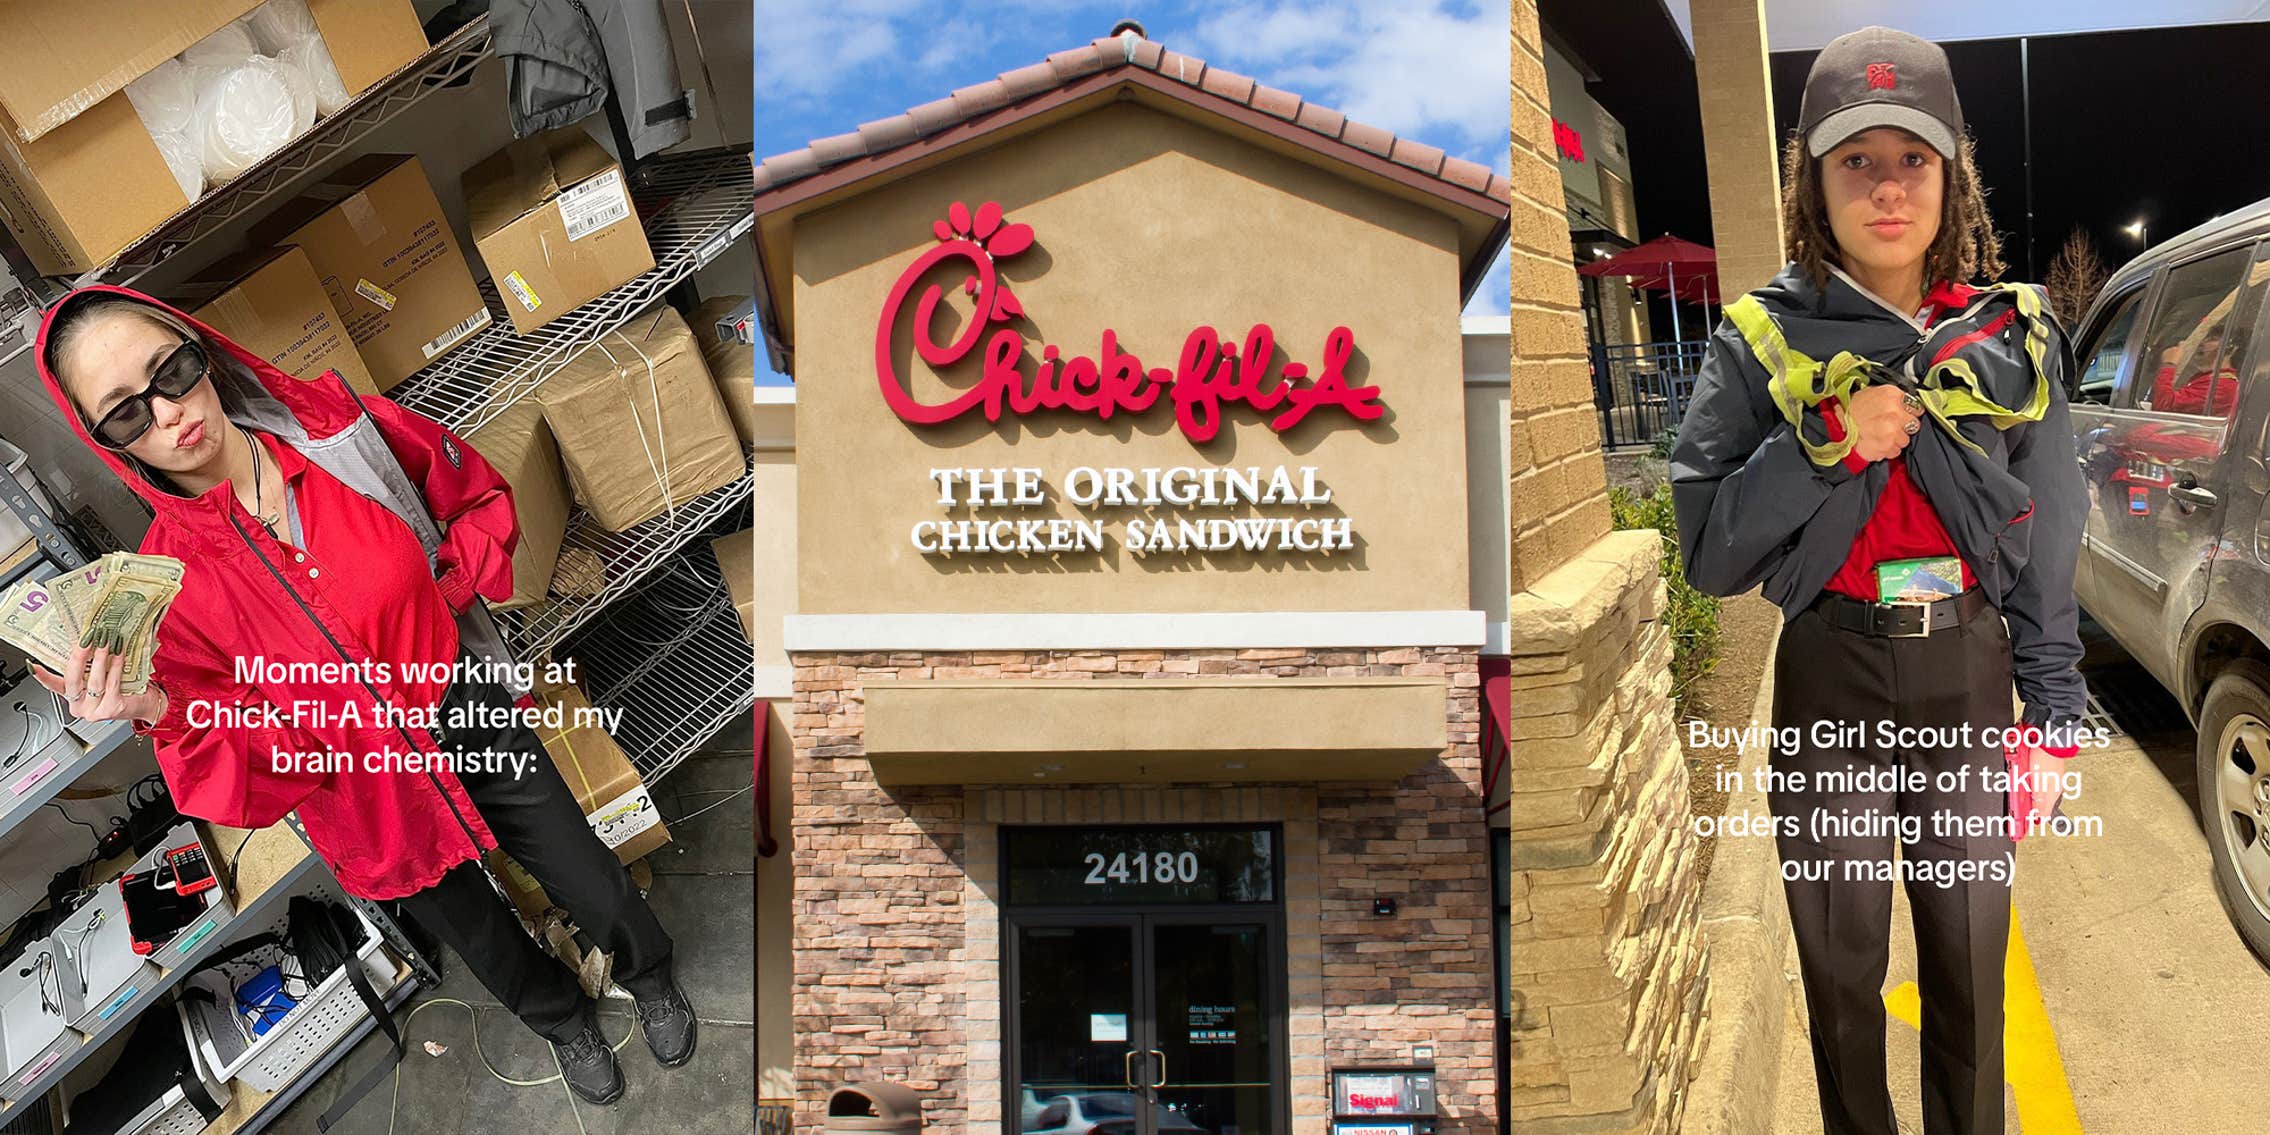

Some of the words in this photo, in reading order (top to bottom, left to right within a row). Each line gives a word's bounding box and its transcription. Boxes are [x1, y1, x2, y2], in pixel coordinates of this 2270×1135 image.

[875, 201, 1387, 444] Chick-fil-A
[929, 465, 1045, 507] THE
[1064, 464, 1332, 507] ORIGINAL
[910, 519, 1104, 554] CHICKEN
[1125, 517, 1354, 553] SANDWICH
[20, 590, 49, 613] 5
[1083, 850, 1199, 886] 24180
[1188, 1005, 1213, 1014] dining
[1213, 1005, 1236, 1014] hours
[1349, 1093, 1399, 1109] Signal
